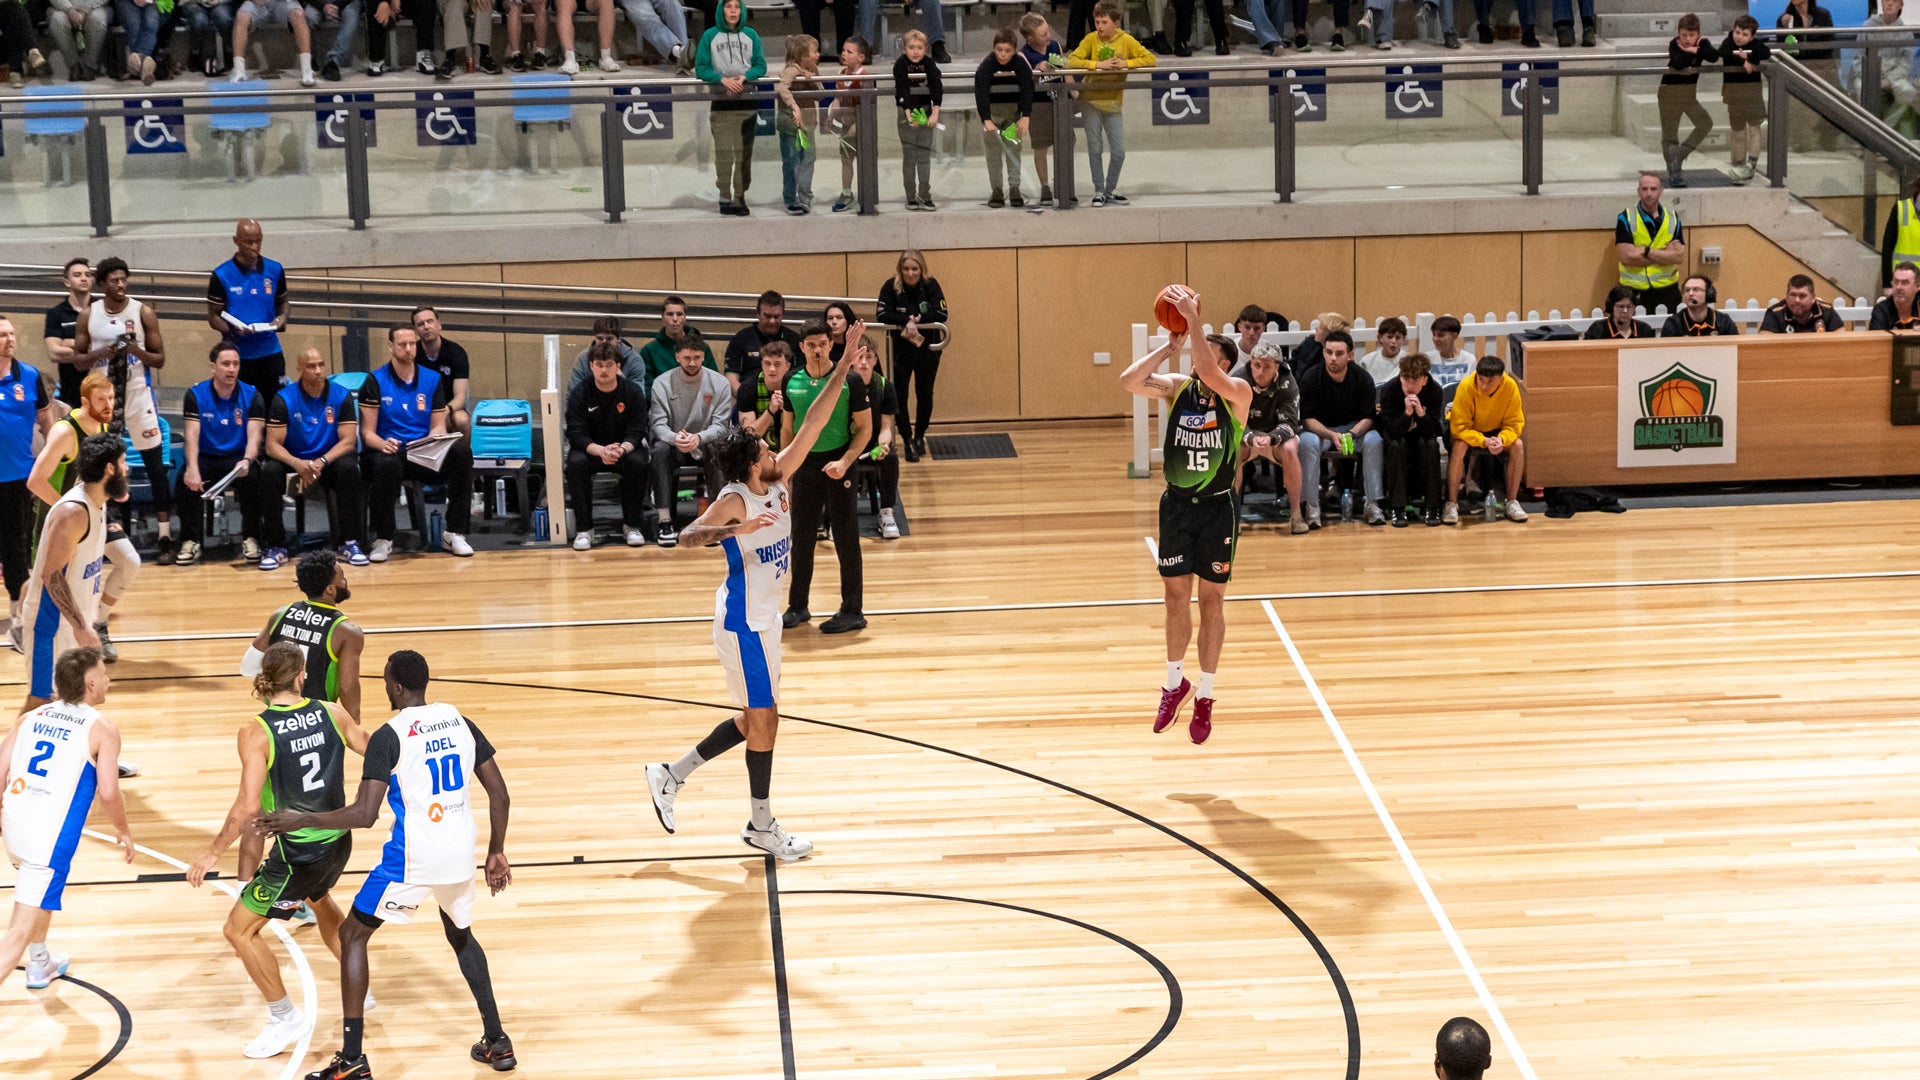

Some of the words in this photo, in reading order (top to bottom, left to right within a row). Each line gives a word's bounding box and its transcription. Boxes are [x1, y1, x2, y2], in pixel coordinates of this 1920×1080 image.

[1174, 427, 1223, 449] PHOENIX
[1635, 423, 1723, 445] BASKETBALL
[1187, 450, 1209, 471] 15
[775, 555, 789, 580] 24
[285, 606, 332, 627] zeller
[280, 623, 312, 643] WALTON
[310, 631, 322, 645] JR
[45, 710, 86, 726] Carnival
[273, 709, 323, 735] zeller
[419, 717, 460, 735] Carnival
[33, 721, 72, 741] WHITE
[290, 731, 326, 754] KENYON
[425, 736, 457, 754] ADEL
[27, 740, 56, 778] 2
[299, 751, 326, 793] 2
[425, 753, 465, 796] 10
